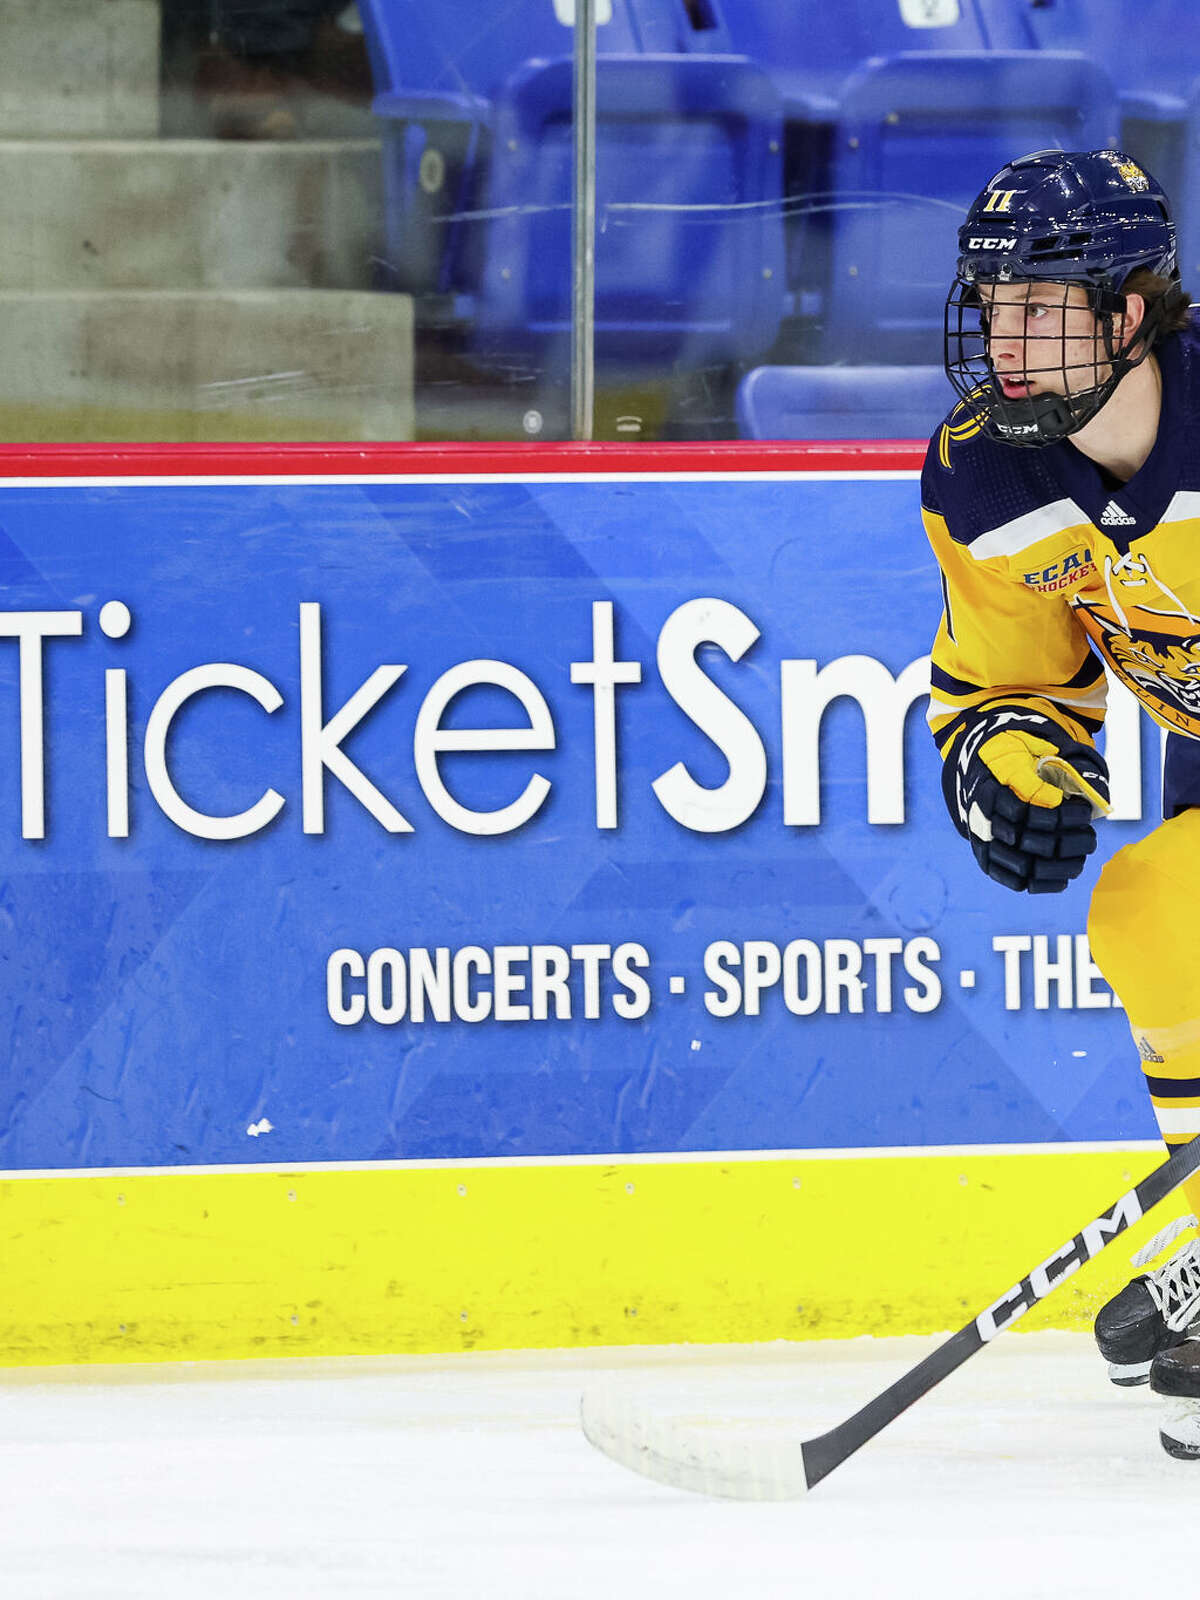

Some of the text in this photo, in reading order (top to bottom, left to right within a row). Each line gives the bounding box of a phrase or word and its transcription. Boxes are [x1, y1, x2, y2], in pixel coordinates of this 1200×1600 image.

[983, 190, 1014, 212] 11
[968, 237, 1017, 251] CCM
[996, 422, 1040, 435] CCM
[1100, 516, 1137, 526] adidas
[326, 941, 651, 1026] CONCERTS
[703, 936, 942, 1017] SPORTS
[975, 1188, 1144, 1343] CCM
